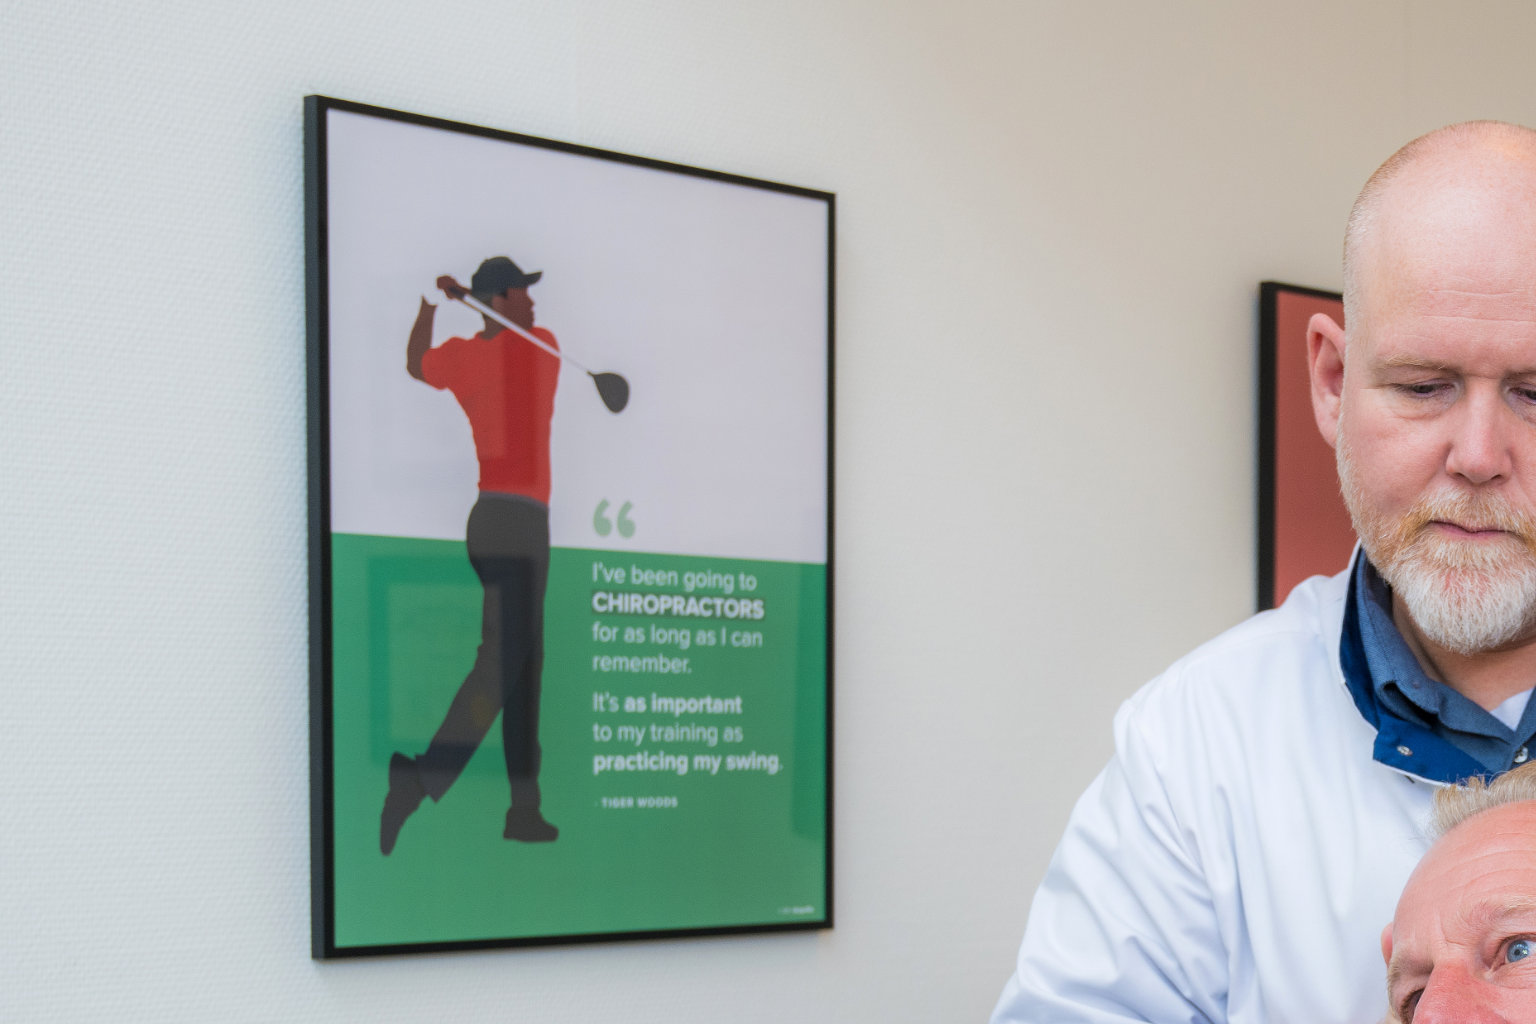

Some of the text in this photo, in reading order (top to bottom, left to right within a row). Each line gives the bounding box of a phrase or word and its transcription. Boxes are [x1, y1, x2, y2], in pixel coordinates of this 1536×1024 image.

[592, 562, 757, 594] I've been going to
[592, 592, 764, 619] CHIROPRACTORS
[592, 621, 763, 649] for as long as I can
[592, 653, 691, 674] remember.
[592, 692, 742, 717] It's as important
[592, 723, 743, 747] to my training as
[593, 751, 688, 775] practicing
[693, 755, 722, 775] my
[602, 797, 678, 808] TIGER WOODS
